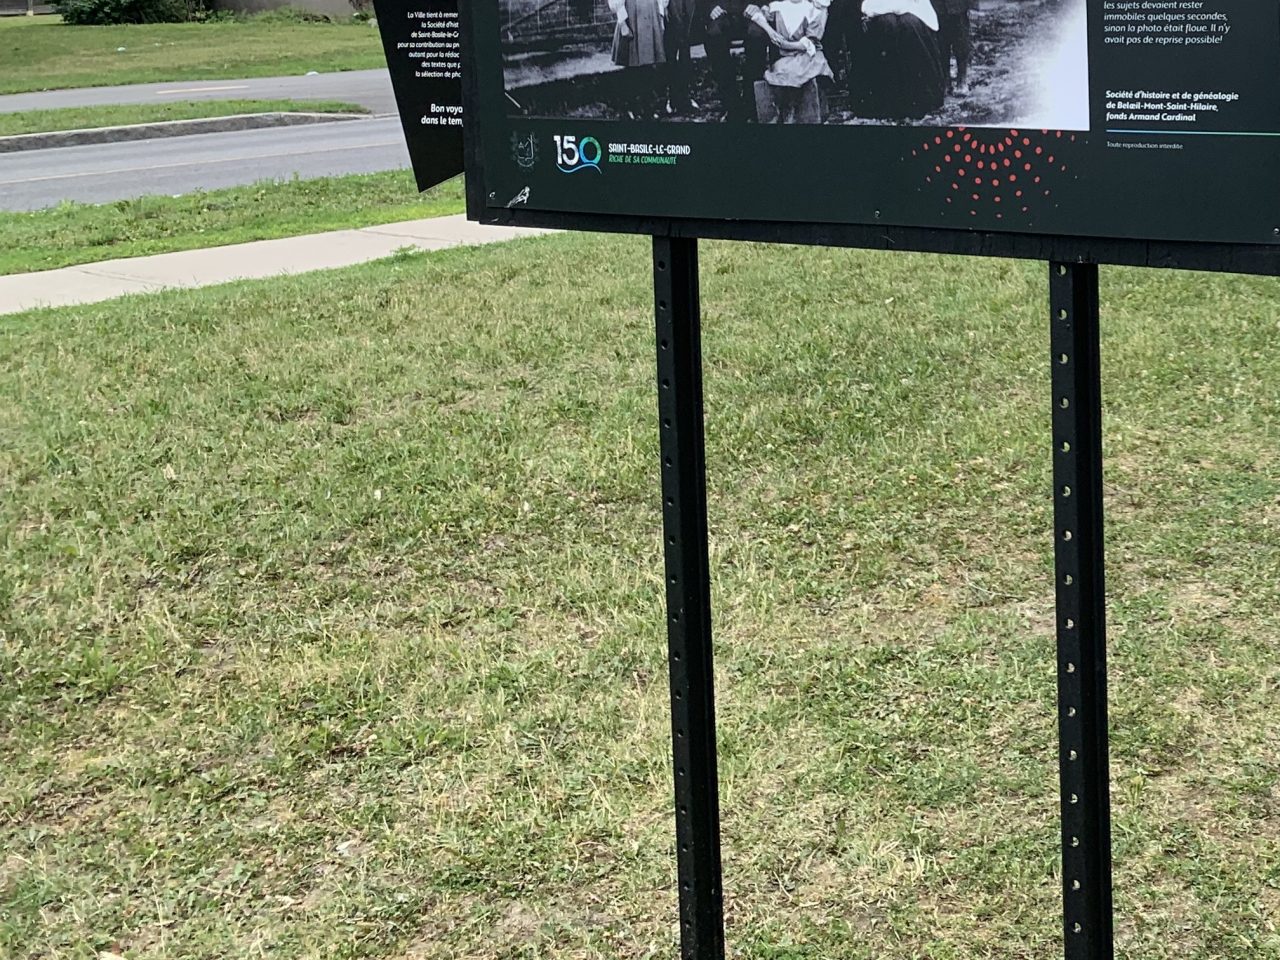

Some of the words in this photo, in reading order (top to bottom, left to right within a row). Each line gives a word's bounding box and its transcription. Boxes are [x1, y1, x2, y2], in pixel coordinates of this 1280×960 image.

[1104, 1, 1115, 9] les
[1116, 0, 1140, 11] sujets
[1141, 0, 1177, 9] devaient
[1179, 0, 1205, 8] rester
[1104, 12, 1146, 20] immobiles
[1147, 12, 1186, 22] quelques
[1187, 12, 1229, 21] secondes,
[1104, 23, 1126, 31] sinon
[1127, 23, 1135, 31] la
[1137, 23, 1162, 34] photo
[1163, 23, 1183, 31] était
[1210, 23, 1216, 31] Il
[1218, 23, 1232, 34] n'y
[1105, 35, 1124, 43] avait
[1126, 36, 1141, 45] pas
[1142, 35, 1153, 43] de
[1155, 35, 1183, 45] reprise
[1185, 35, 1224, 45] possible!
[1106, 90, 1132, 99] Société
[1134, 90, 1170, 99] d'histoire
[1171, 91, 1180, 99] et
[1181, 91, 1191, 99] de
[1193, 91, 1240, 102] généalogie
[1107, 100, 1116, 109] de
[448, 115, 464, 127] tem
[1107, 111, 1127, 122] fonds
[1129, 112, 1160, 120] Armand
[1161, 112, 1197, 121] Cardinal
[554, 135, 602, 165] 150
[608, 143, 691, 154] SAINT-BASILE-LE-GRAND
